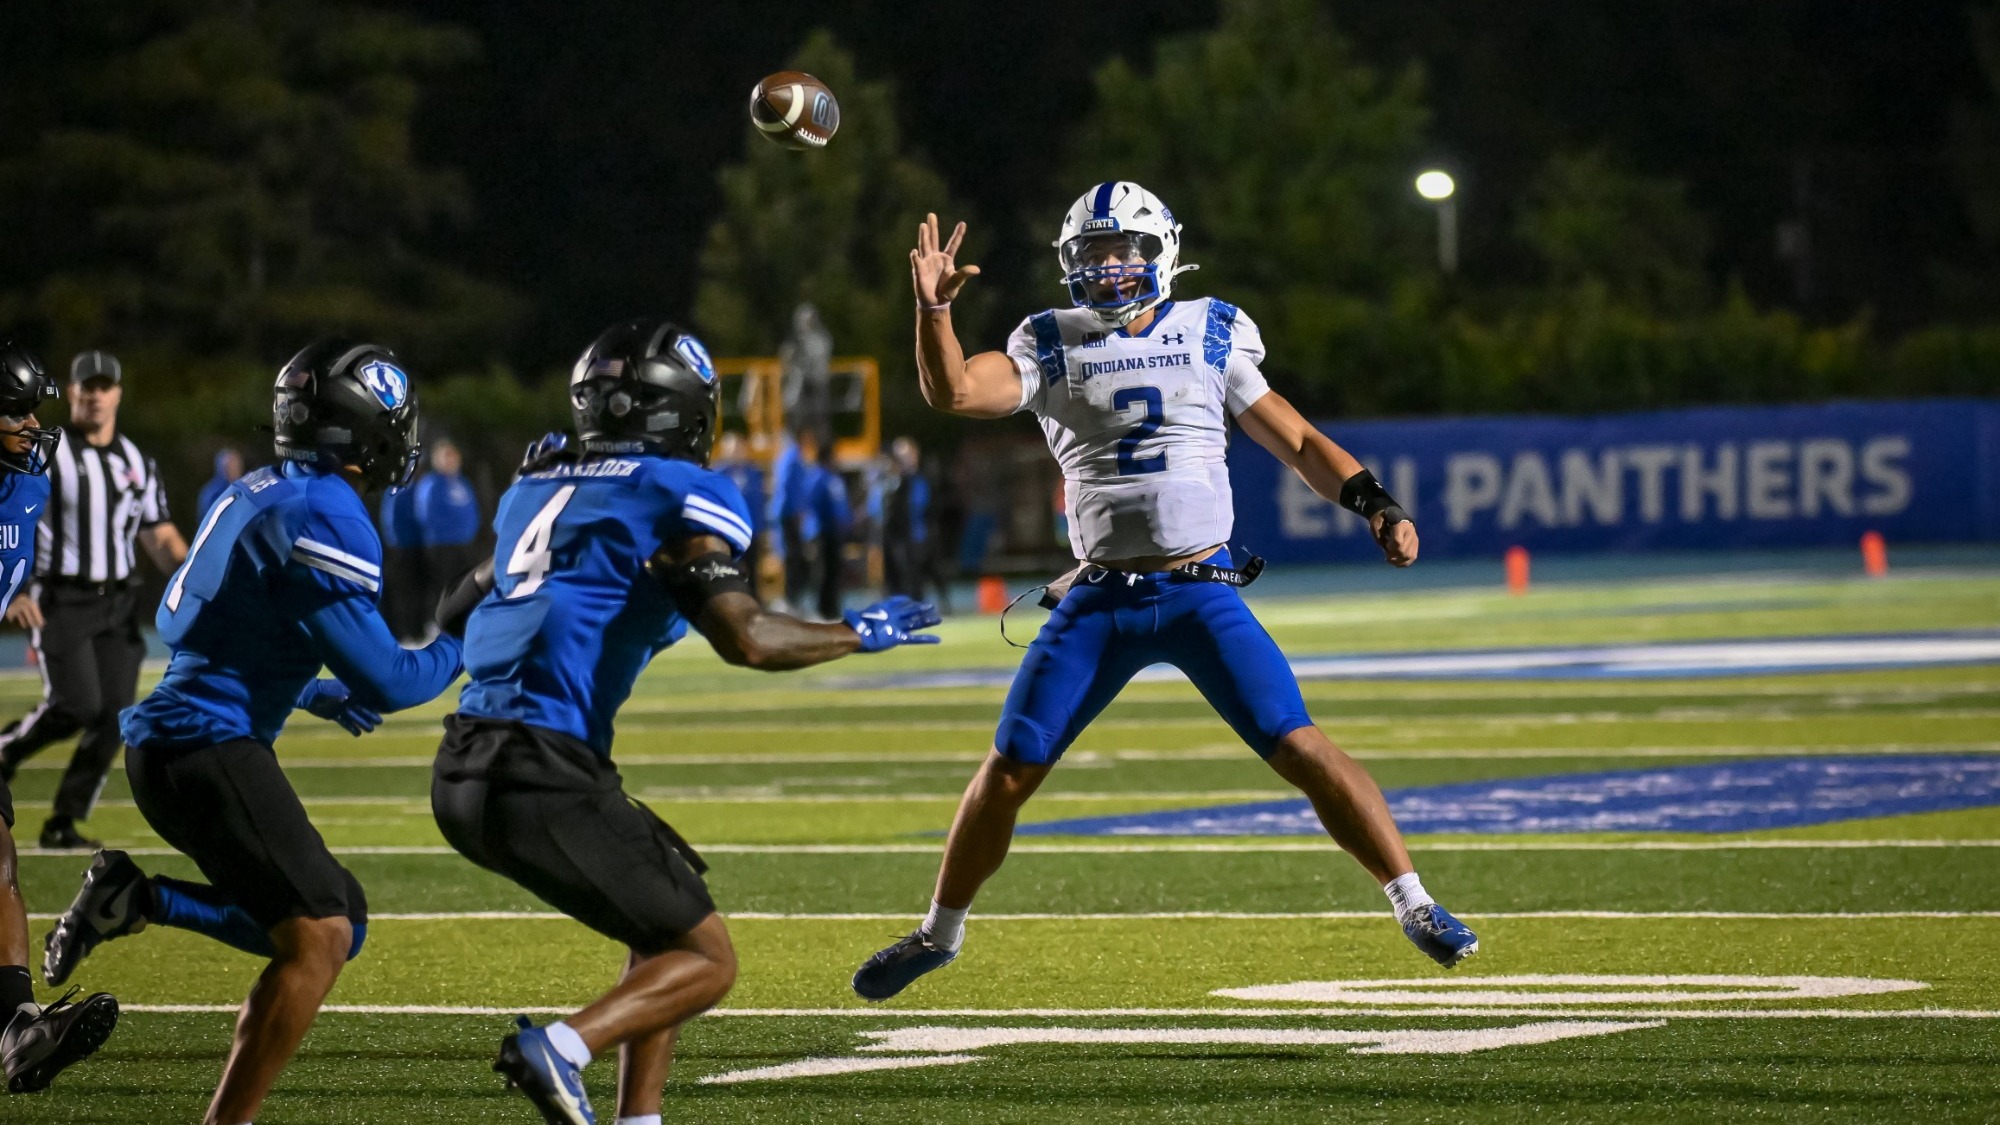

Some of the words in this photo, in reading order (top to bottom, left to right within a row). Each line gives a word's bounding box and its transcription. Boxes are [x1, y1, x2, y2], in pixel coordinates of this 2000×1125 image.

[1085, 218, 1114, 230] STATE
[1148, 353, 1191, 368] STATE
[1110, 384, 1169, 477] 2
[1445, 436, 1914, 533] PANTHERS
[166, 496, 234, 612] 1
[507, 485, 575, 599] 4
